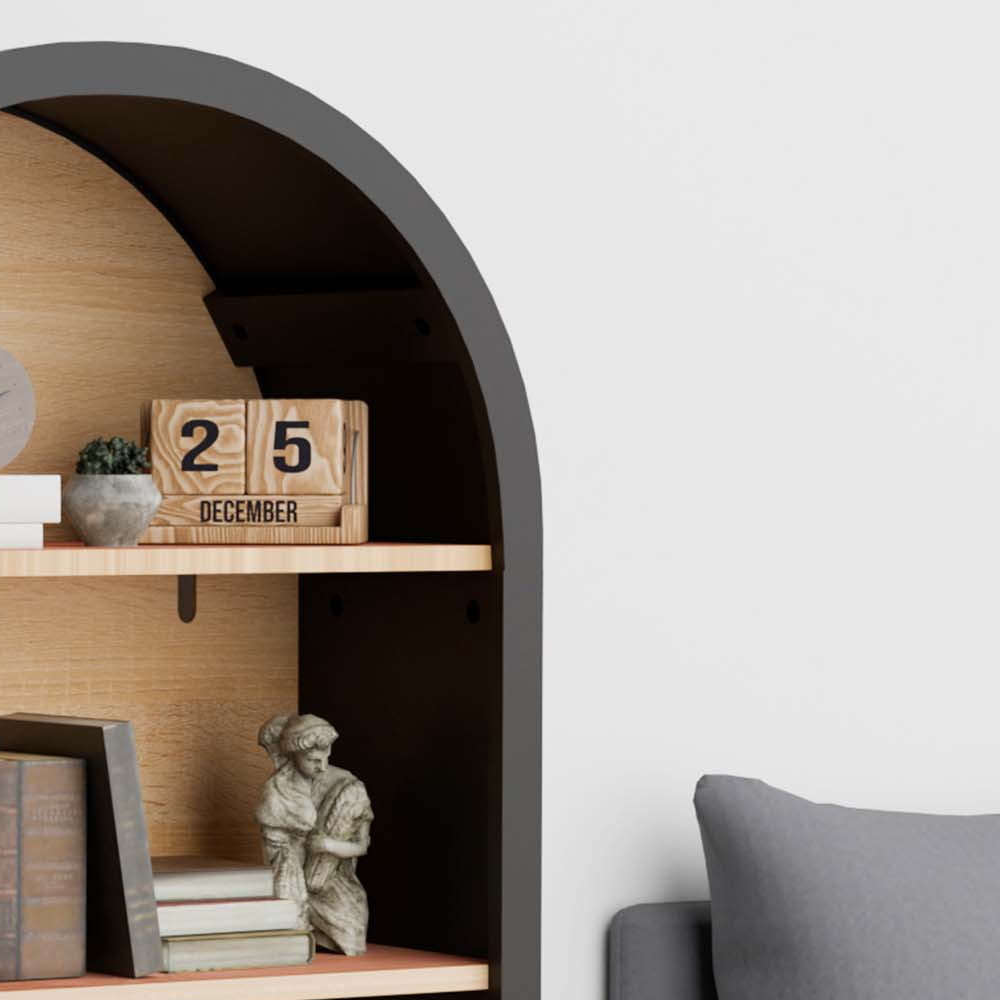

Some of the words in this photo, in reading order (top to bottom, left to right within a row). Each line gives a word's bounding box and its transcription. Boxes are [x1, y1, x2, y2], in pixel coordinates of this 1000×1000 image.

[181, 419, 219, 471] 2
[273, 421, 312, 473] 5
[200, 500, 297, 523] DECEMBER
